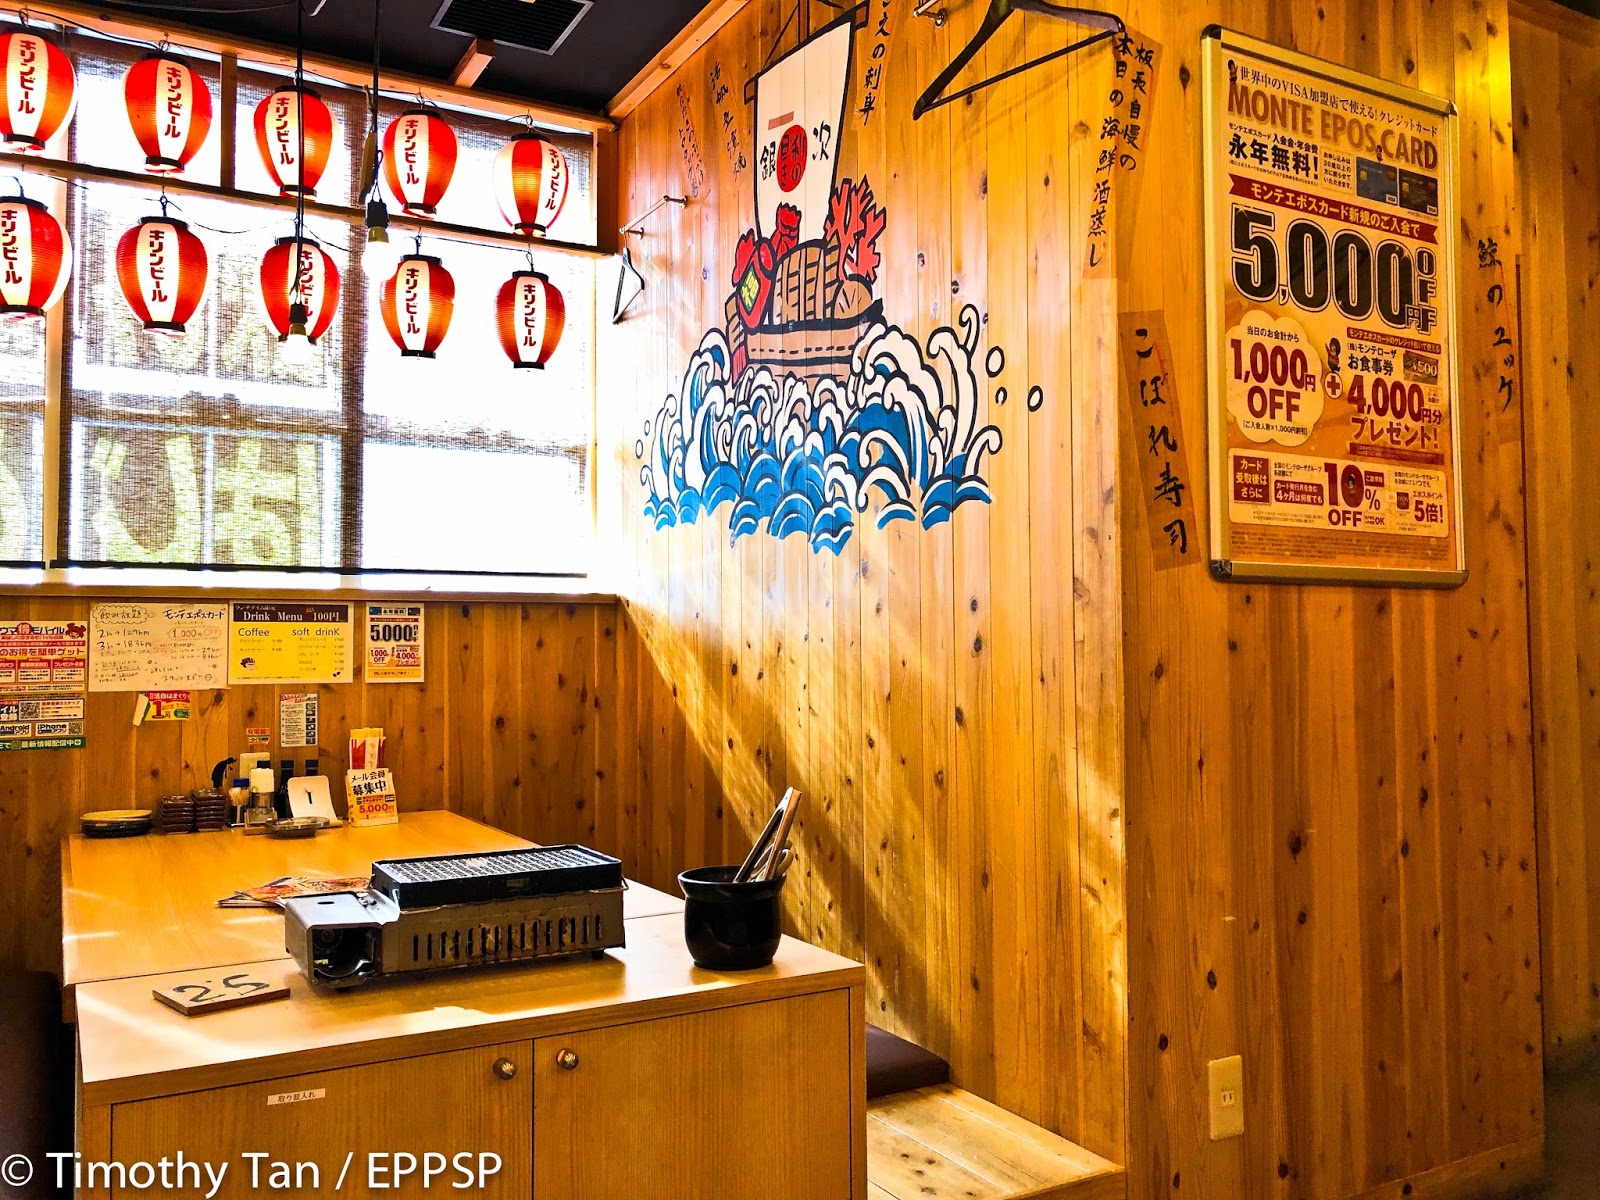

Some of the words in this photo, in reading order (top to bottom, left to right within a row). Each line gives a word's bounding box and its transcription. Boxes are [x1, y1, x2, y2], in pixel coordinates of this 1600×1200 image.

[18, 40, 36, 114] キリンビール
[859, 0, 891, 126] えの刺身
[164, 67, 182, 138] キリンビール
[1120, 42, 1154, 171] 板長自慢の
[1227, 83, 1312, 136] MONTE
[1320, 109, 1376, 153] EPOS
[1381, 129, 1439, 170] CARD
[276, 97, 294, 165] キリンビール
[404, 119, 419, 185] キリンビール
[760, 141, 776, 181] 銀
[812, 121, 831, 161] 次
[1228, 133, 1318, 180] 永年無料!
[544, 148, 562, 210] キリンビール
[1250, 182, 1421, 238] モンテエポスカード新規のご入会で
[1, 209, 22, 284] キリンビール
[149, 230, 168, 302] キリンビール
[405, 268, 420, 334] キリンビール
[523, 284, 536, 346] キリンビール
[1230, 338, 1316, 392] 1,000円
[1347, 353, 1394, 376] お食事券
[1247, 385, 1300, 422] OFF
[1135, 328, 1187, 554] こぼれ寿司
[1352, 416, 1439, 449] プレゼント!
[1240, 459, 1263, 471] カード
[1240, 486, 1263, 499] さらに
[1328, 508, 1363, 527] OFF
[1414, 499, 1444, 524] 5倍!
[238, 628, 270, 637] Coffee
[243, 611, 270, 621] Drink
[278, 611, 303, 621] Menu
[313, 612, 339, 622] 100円
[292, 627, 310, 636] soft
[351, 770, 386, 783] メール会員
[352, 779, 387, 796] 募集中
